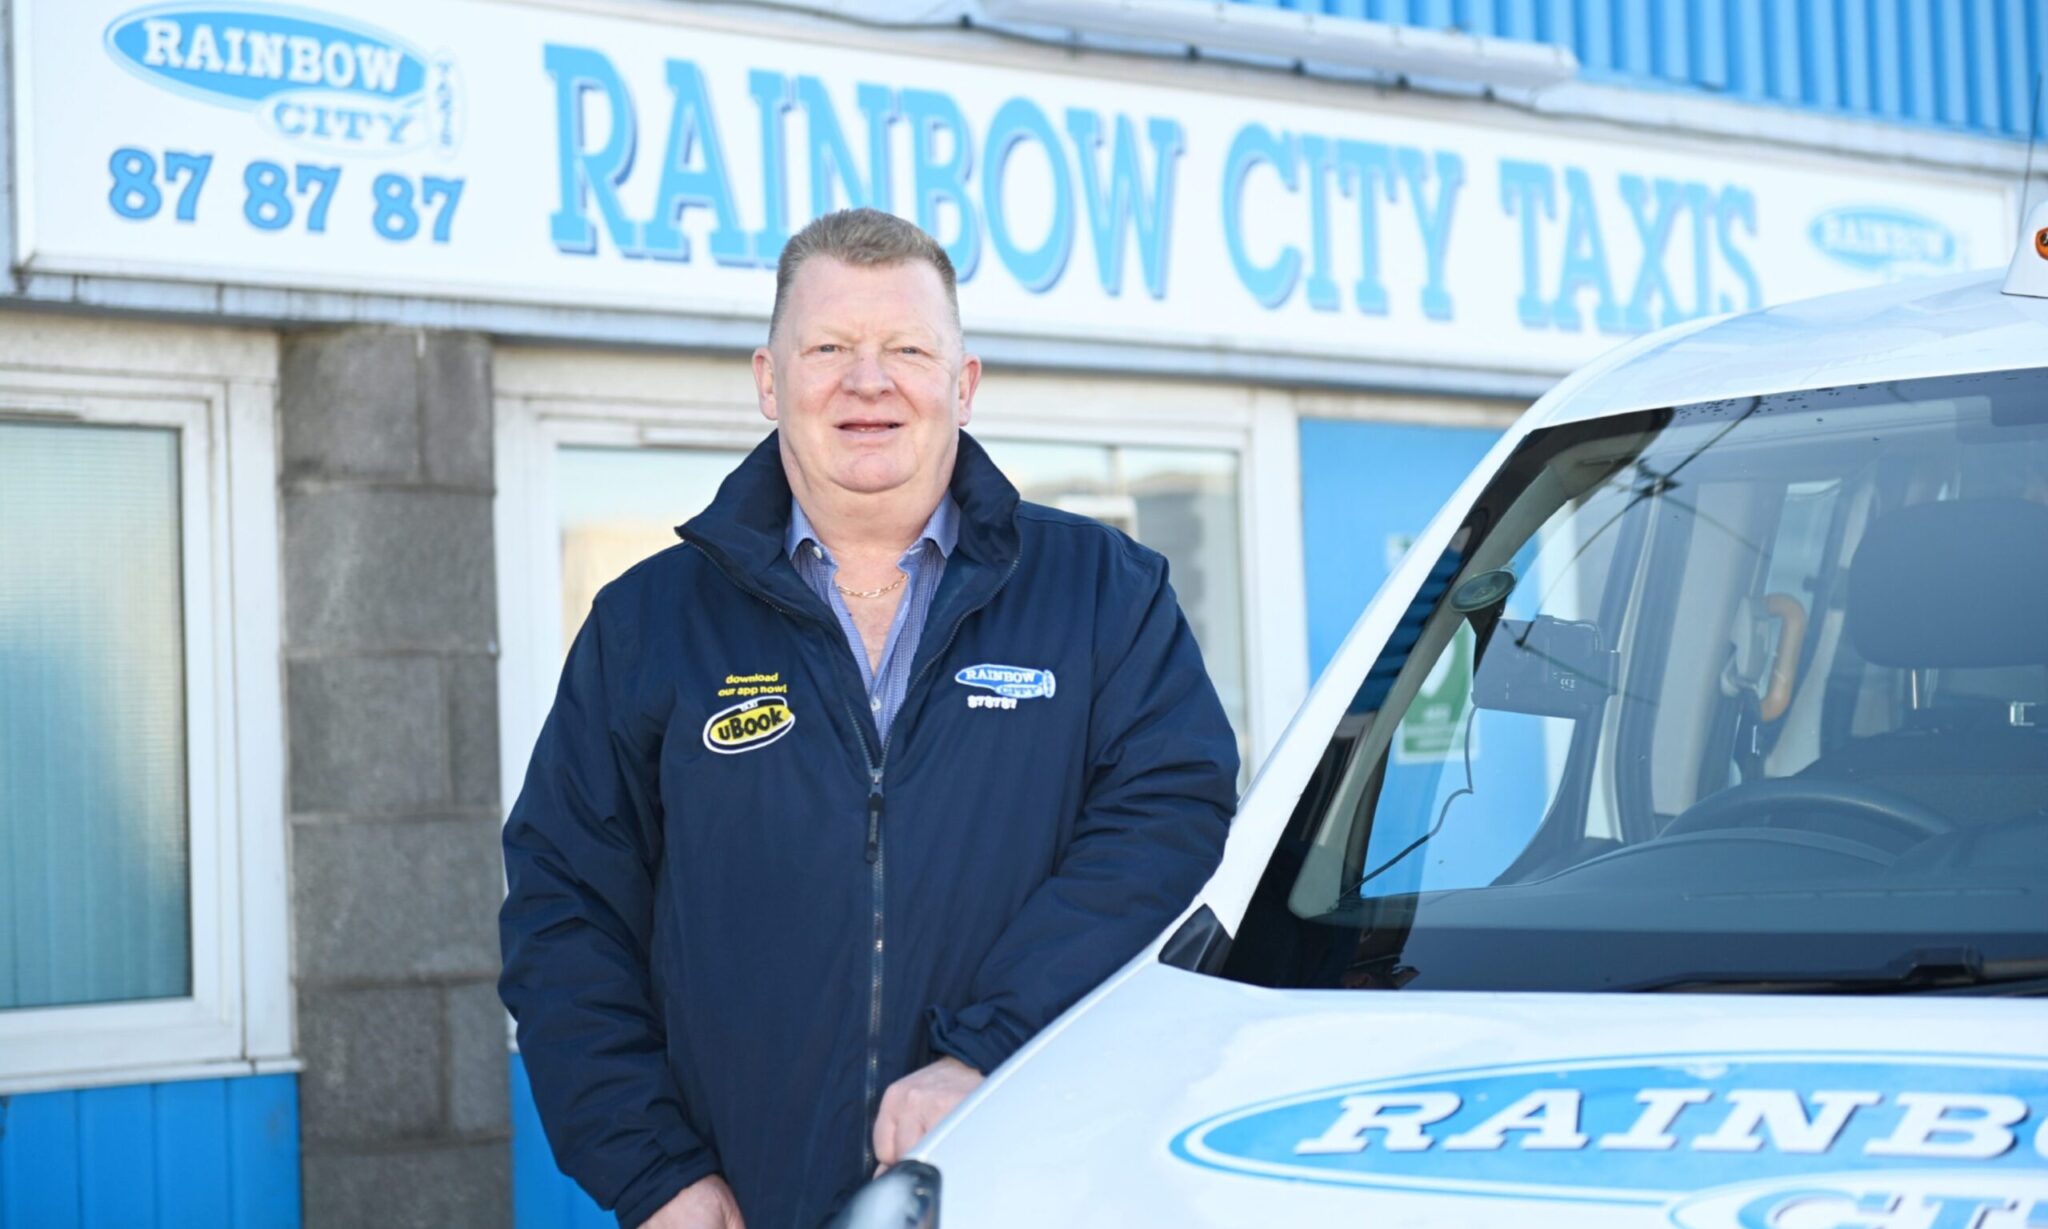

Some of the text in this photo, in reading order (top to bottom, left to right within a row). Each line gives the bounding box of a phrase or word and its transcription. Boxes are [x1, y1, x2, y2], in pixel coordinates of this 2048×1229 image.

[143, 19, 405, 91] RAINBOW
[273, 101, 417, 145] CITY
[107, 147, 465, 243] 87 87 87
[543, 43, 1763, 334] RAINBOW CITY TAXIS
[718, 684, 787, 697] our app now!
[725, 672, 779, 684] download
[965, 669, 1035, 682] RAINBOW
[1294, 1089, 2048, 1159] RAINB
